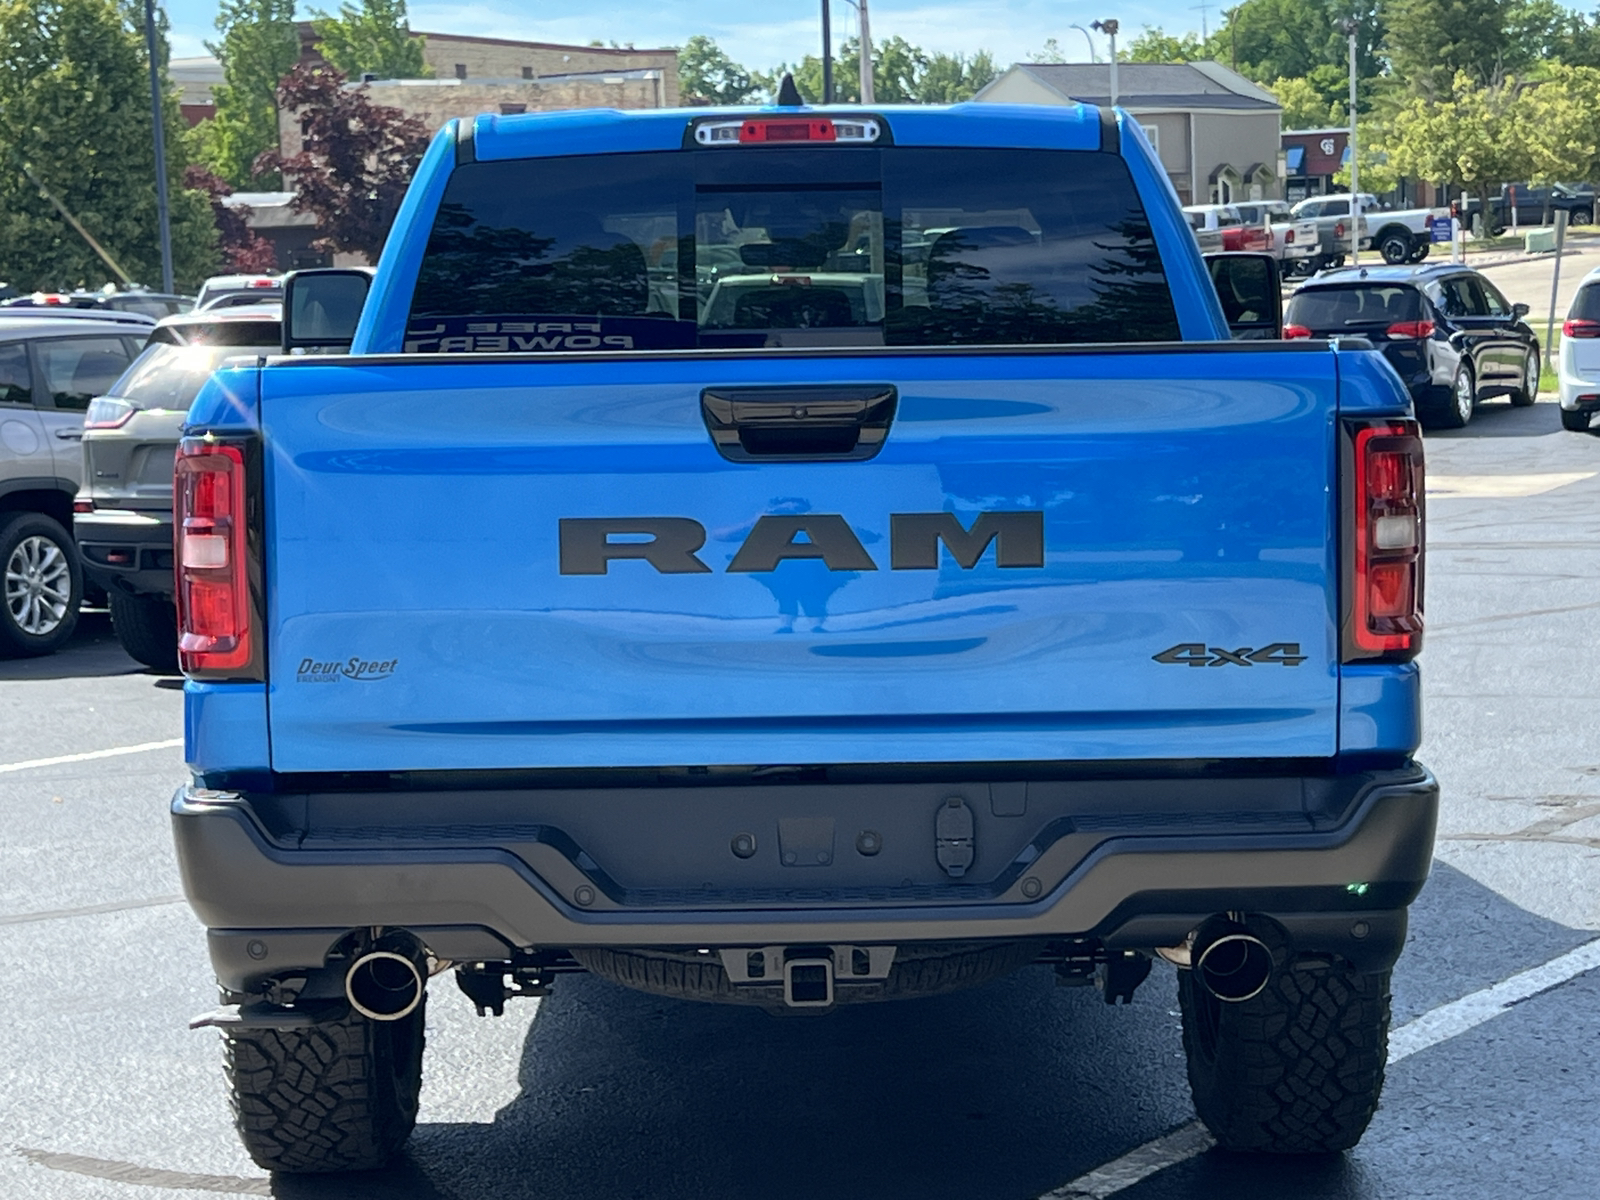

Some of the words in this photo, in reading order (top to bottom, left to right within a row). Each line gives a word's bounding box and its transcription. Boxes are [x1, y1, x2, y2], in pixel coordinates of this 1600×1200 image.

[559, 511, 1044, 575] RAM
[1151, 643, 1309, 667] 4x4
[297, 658, 342, 675] Deur
[344, 657, 398, 678] Speet
